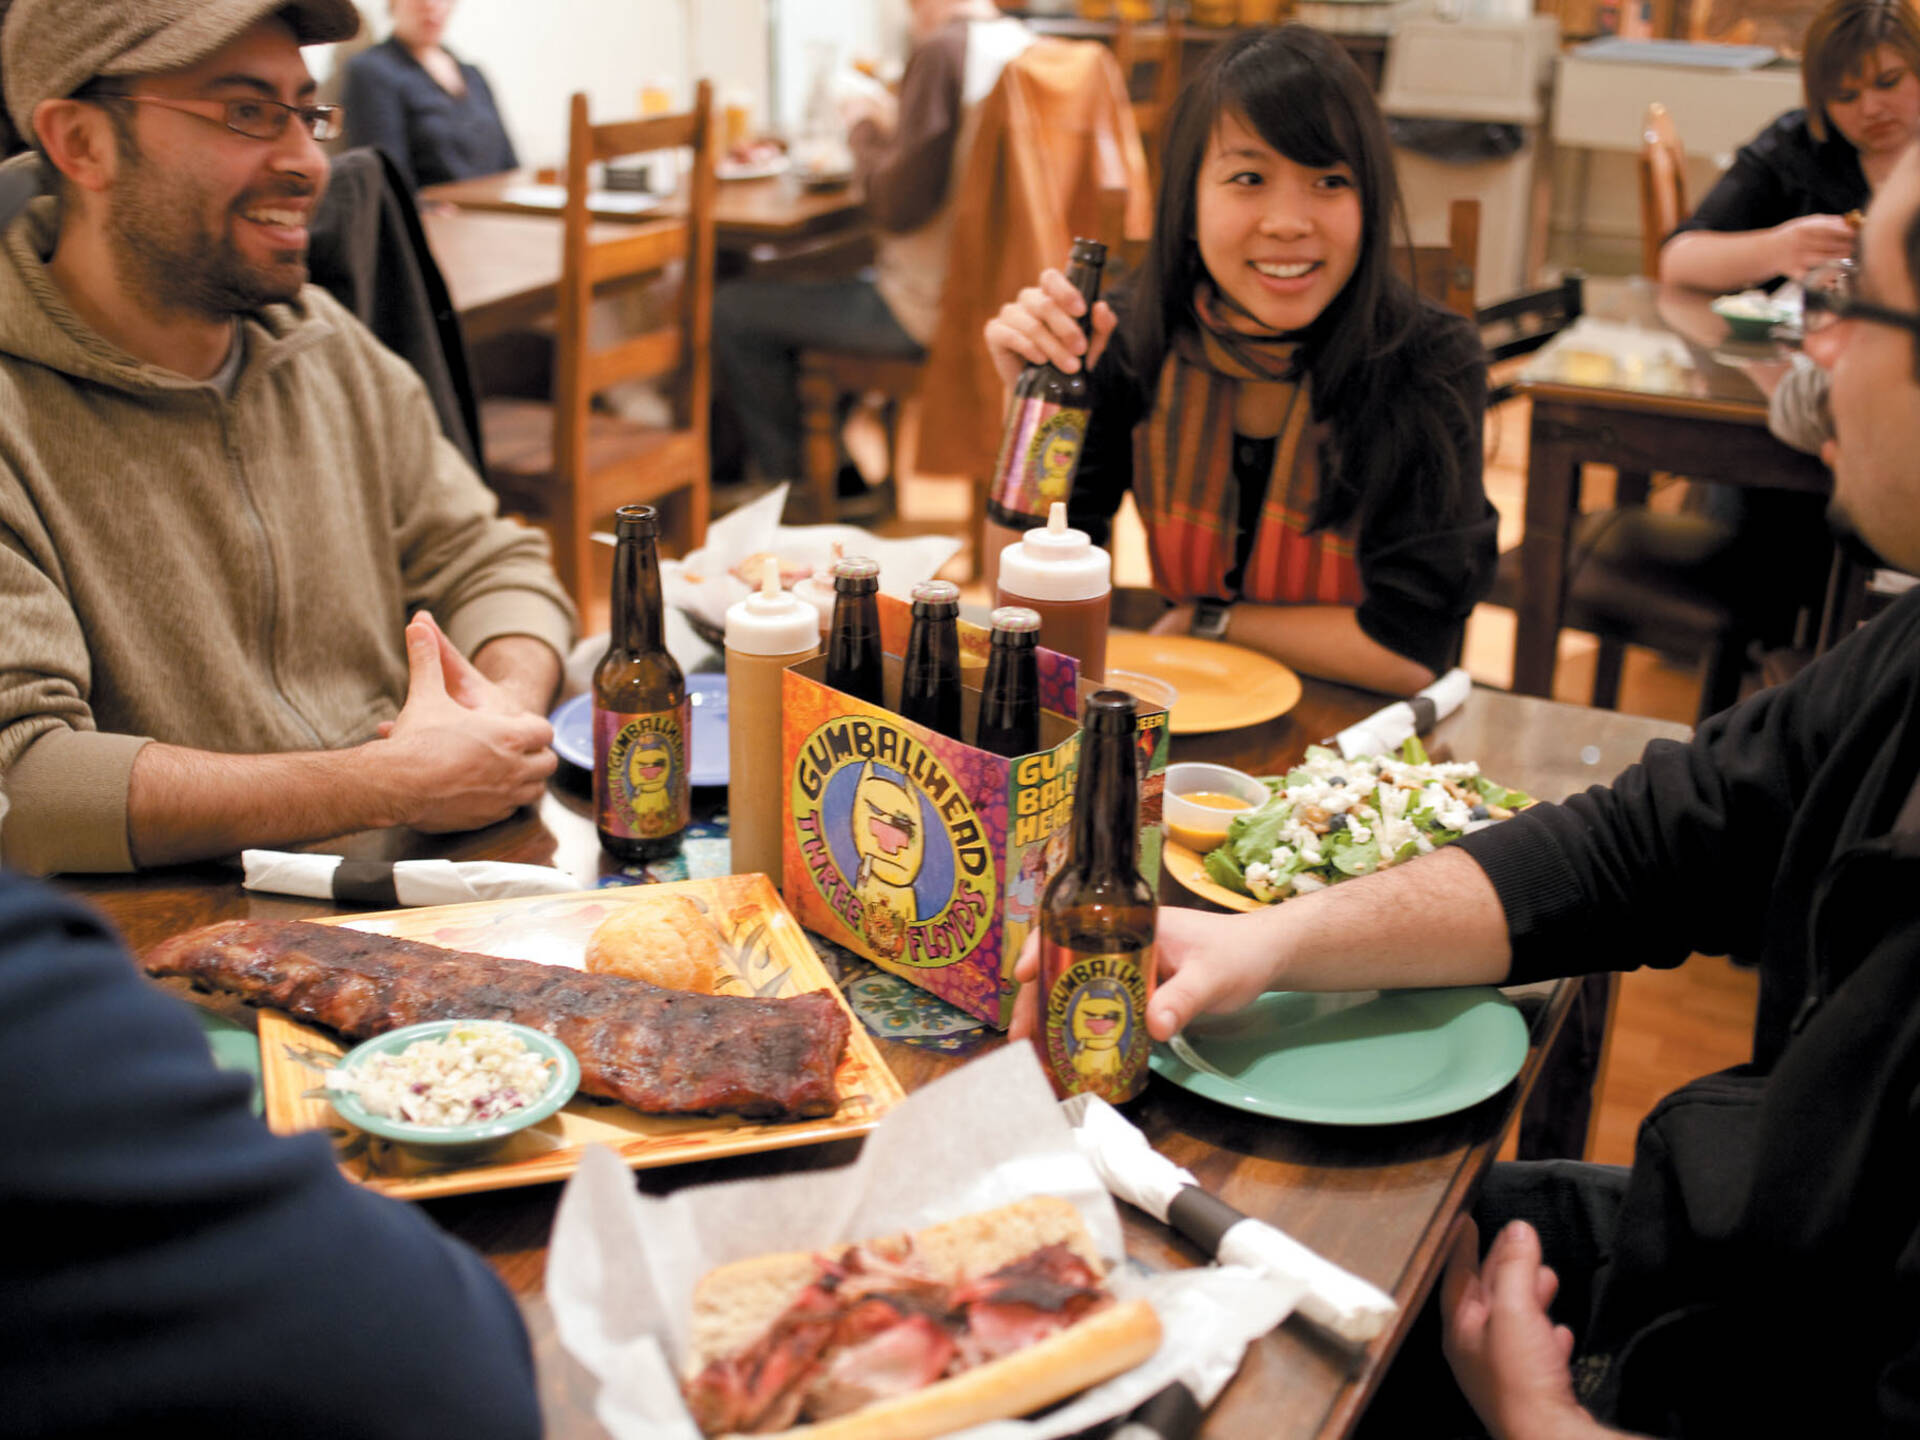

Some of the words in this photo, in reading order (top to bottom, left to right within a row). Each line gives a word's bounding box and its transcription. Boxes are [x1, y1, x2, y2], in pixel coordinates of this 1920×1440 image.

[799, 721, 987, 876] GUMBALLHEAD
[1136, 714, 1165, 730] EER
[797, 808, 865, 930] THREE
[907, 878, 986, 961] FLOYDS
